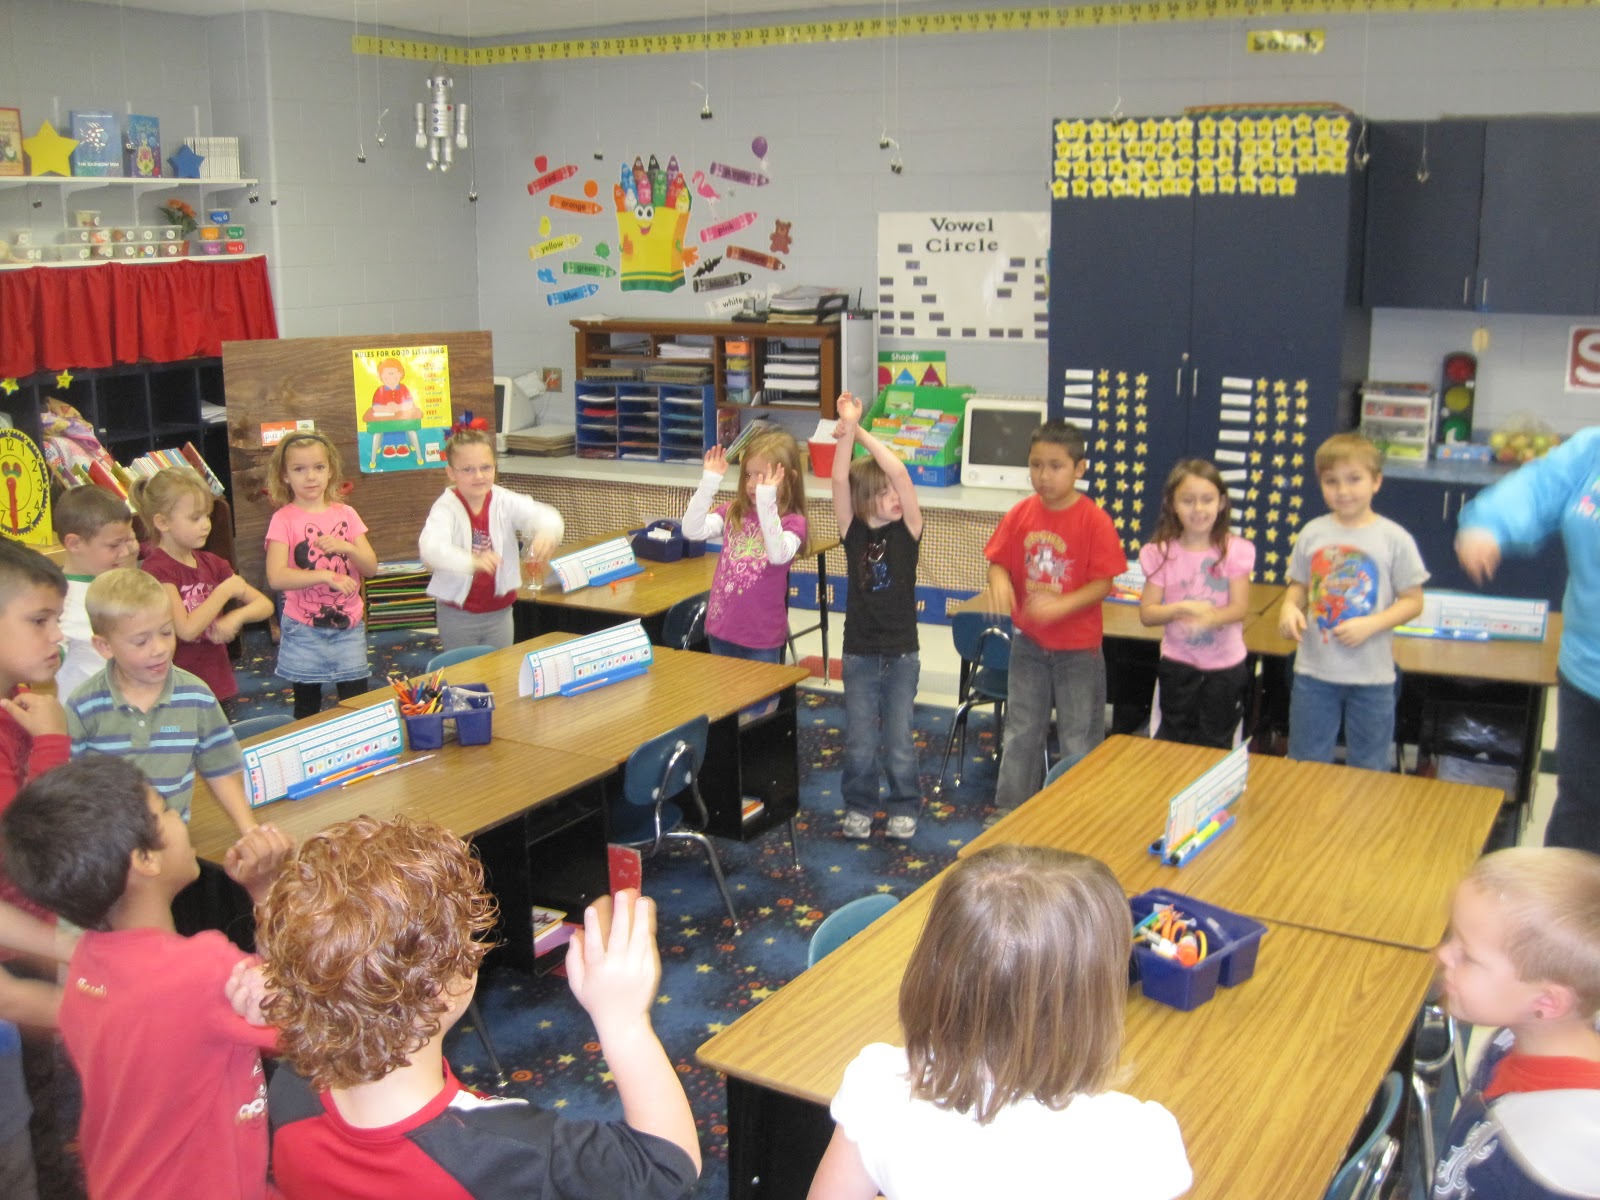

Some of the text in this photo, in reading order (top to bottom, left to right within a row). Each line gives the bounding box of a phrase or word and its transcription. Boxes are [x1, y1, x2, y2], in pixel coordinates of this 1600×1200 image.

[464, 50, 470, 58] 10
[486, 49, 493, 57] 12
[498, 48, 505, 56] 13
[511, 47, 518, 55] 14
[524, 46, 531, 54] 15
[538, 45, 545, 53] 16
[551, 44, 558, 52] 17
[563, 43, 570, 51] 18
[577, 42, 584, 50] 19
[590, 41, 599, 49] 20
[603, 41, 610, 49] 21
[616, 40, 624, 48] 22
[630, 39, 638, 47] 23
[644, 38, 652, 46] 24
[658, 37, 667, 46] 25
[672, 36, 682, 44] 26
[687, 34, 696, 43] 27
[702, 34, 711, 42] 28
[716, 32, 726, 41] 29
[732, 31, 740, 40] 30
[745, 30, 752, 39] 31
[760, 29, 768, 38] 32
[775, 28, 784, 36] 33
[806, 25, 816, 34] 35
[822, 24, 832, 32] 36
[838, 22, 848, 31] 37
[854, 22, 864, 30] 38
[870, 20, 880, 28] 39
[886, 19, 896, 28] 40
[902, 17, 910, 26] 41
[917, 16, 928, 26] 42
[934, 15, 945, 24] 43
[950, 14, 962, 23] 44
[968, 13, 979, 22] 45
[985, 12, 996, 21] 46
[1002, 11, 1014, 20] 47
[562, 200, 586, 212] orange
[718, 222, 734, 236] pink
[930, 218, 994, 232] Vowel
[542, 242, 564, 254] yellow
[926, 238, 998, 252] Circle
[710, 279, 730, 288] black
[563, 292, 578, 300] blue
[722, 297, 742, 308] white
[354, 350, 374, 358] RULES
[377, 349, 390, 357] FOR
[412, 348, 445, 356] LISTENING
[891, 352, 919, 362] Shapes
[6, 438, 14, 451] 12
[21, 444, 24, 456] 1
[32, 460, 38, 472] 2
[37, 479, 42, 492] 3
[34, 500, 40, 511] 4
[0, 510, 6, 520] 7
[26, 512, 32, 524] 5
